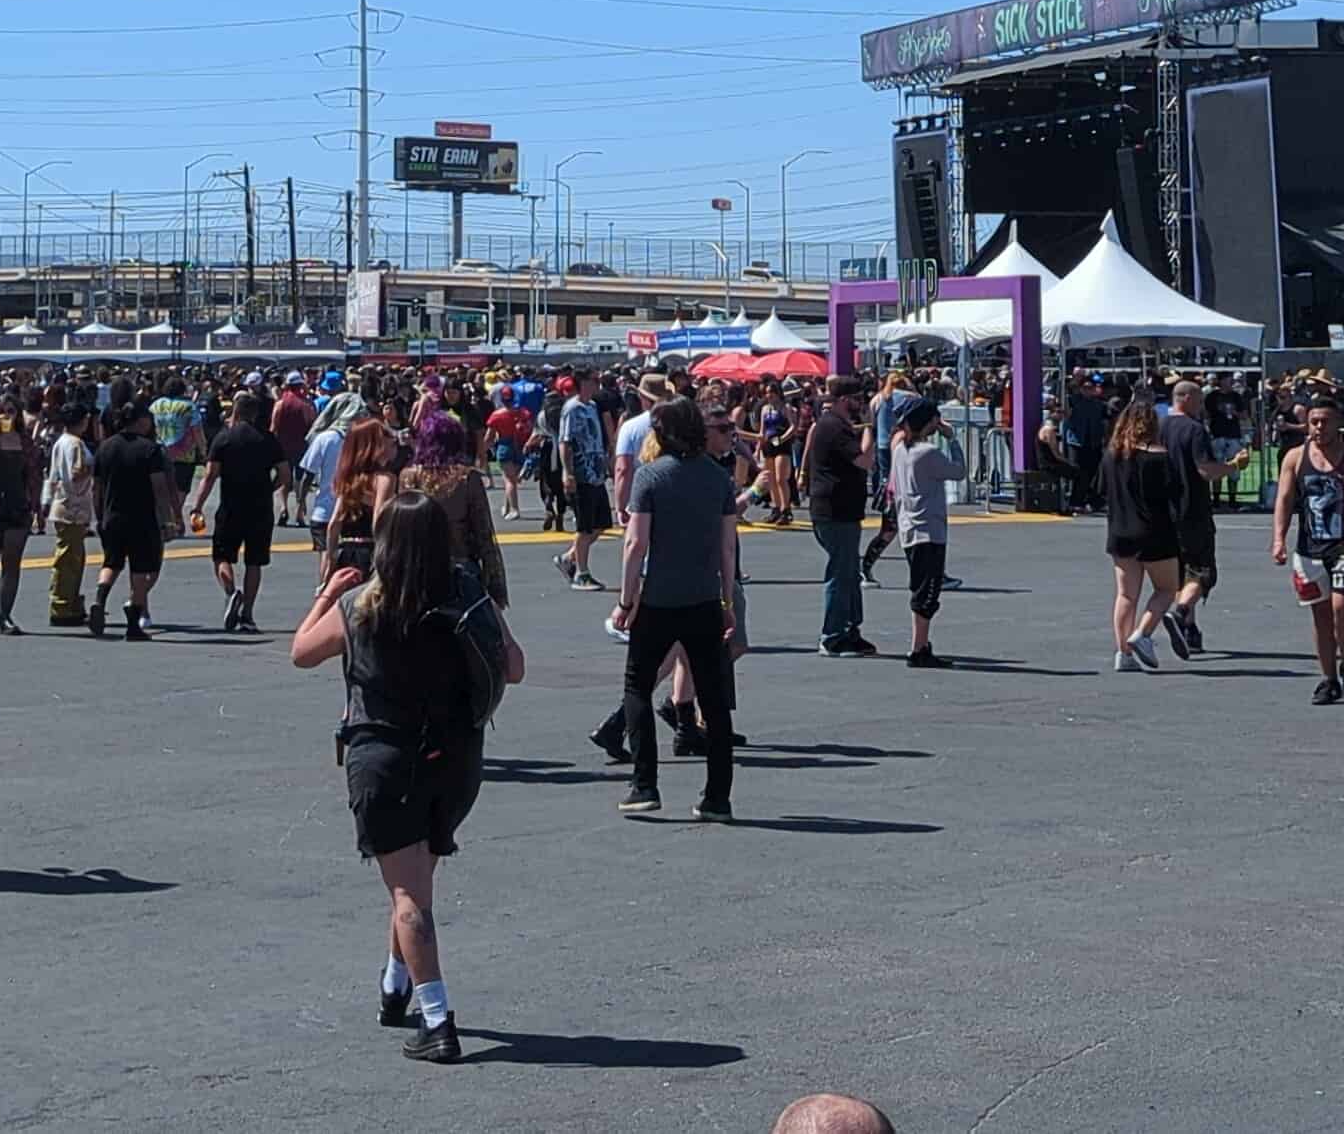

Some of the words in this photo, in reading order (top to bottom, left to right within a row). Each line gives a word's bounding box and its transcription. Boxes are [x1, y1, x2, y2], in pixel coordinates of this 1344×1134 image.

[994, 3, 1030, 46] SICK
[410, 146, 439, 163] STN
[442, 148, 479, 165] EARN
[898, 258, 937, 324] VIP
